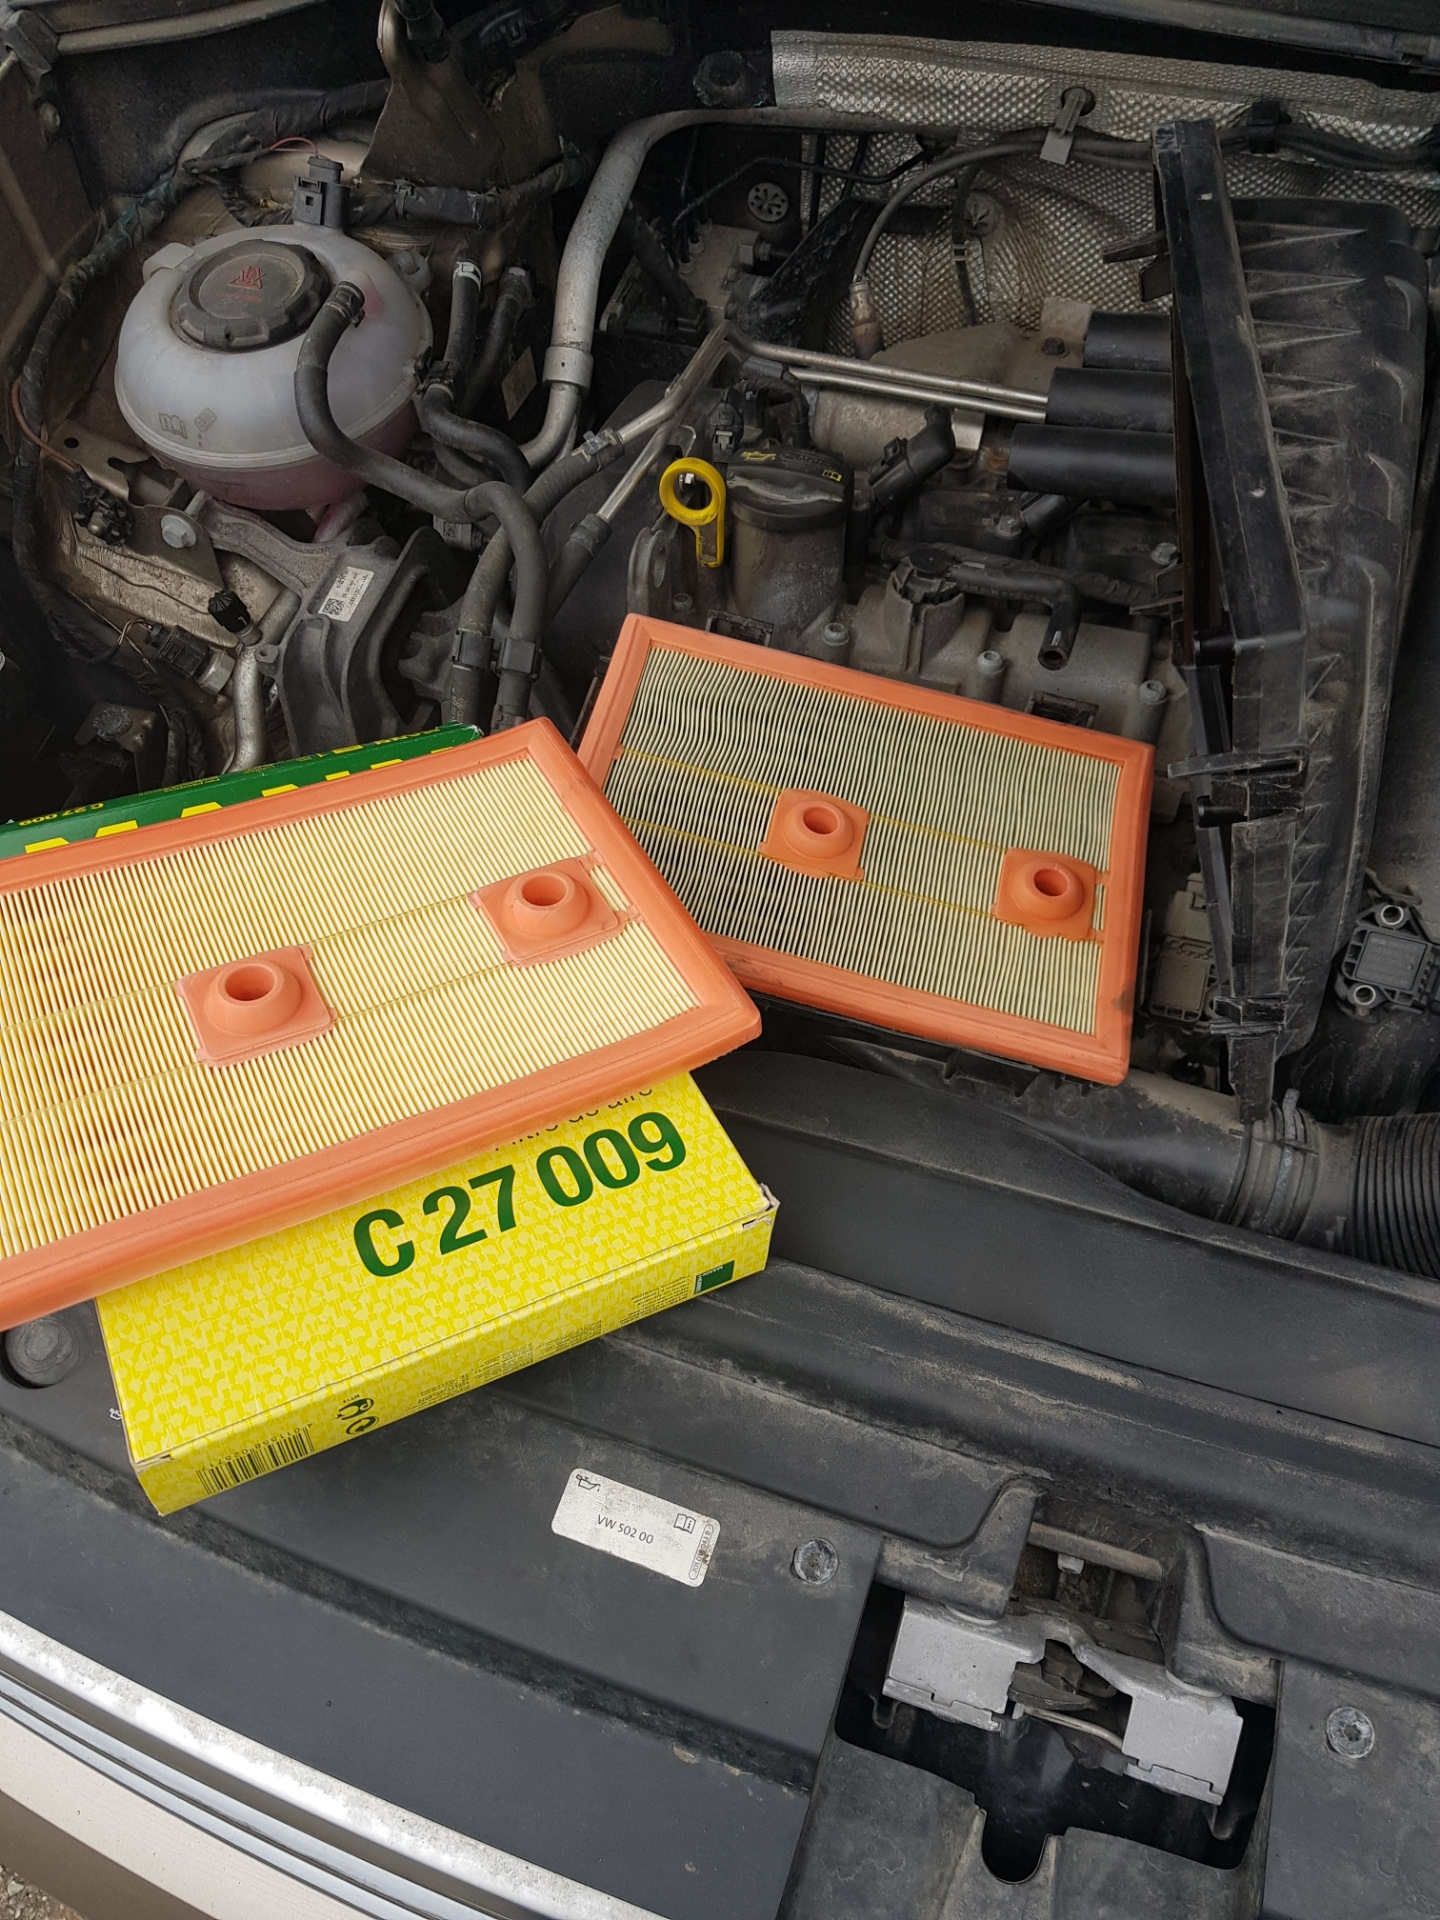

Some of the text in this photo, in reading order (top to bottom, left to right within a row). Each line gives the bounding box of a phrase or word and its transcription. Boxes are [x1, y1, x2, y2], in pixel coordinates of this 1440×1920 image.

[18, 802, 104, 826] C 27 009
[353, 1112, 686, 1277] C 27 009
[597, 1514, 654, 1544] VW 502 00
